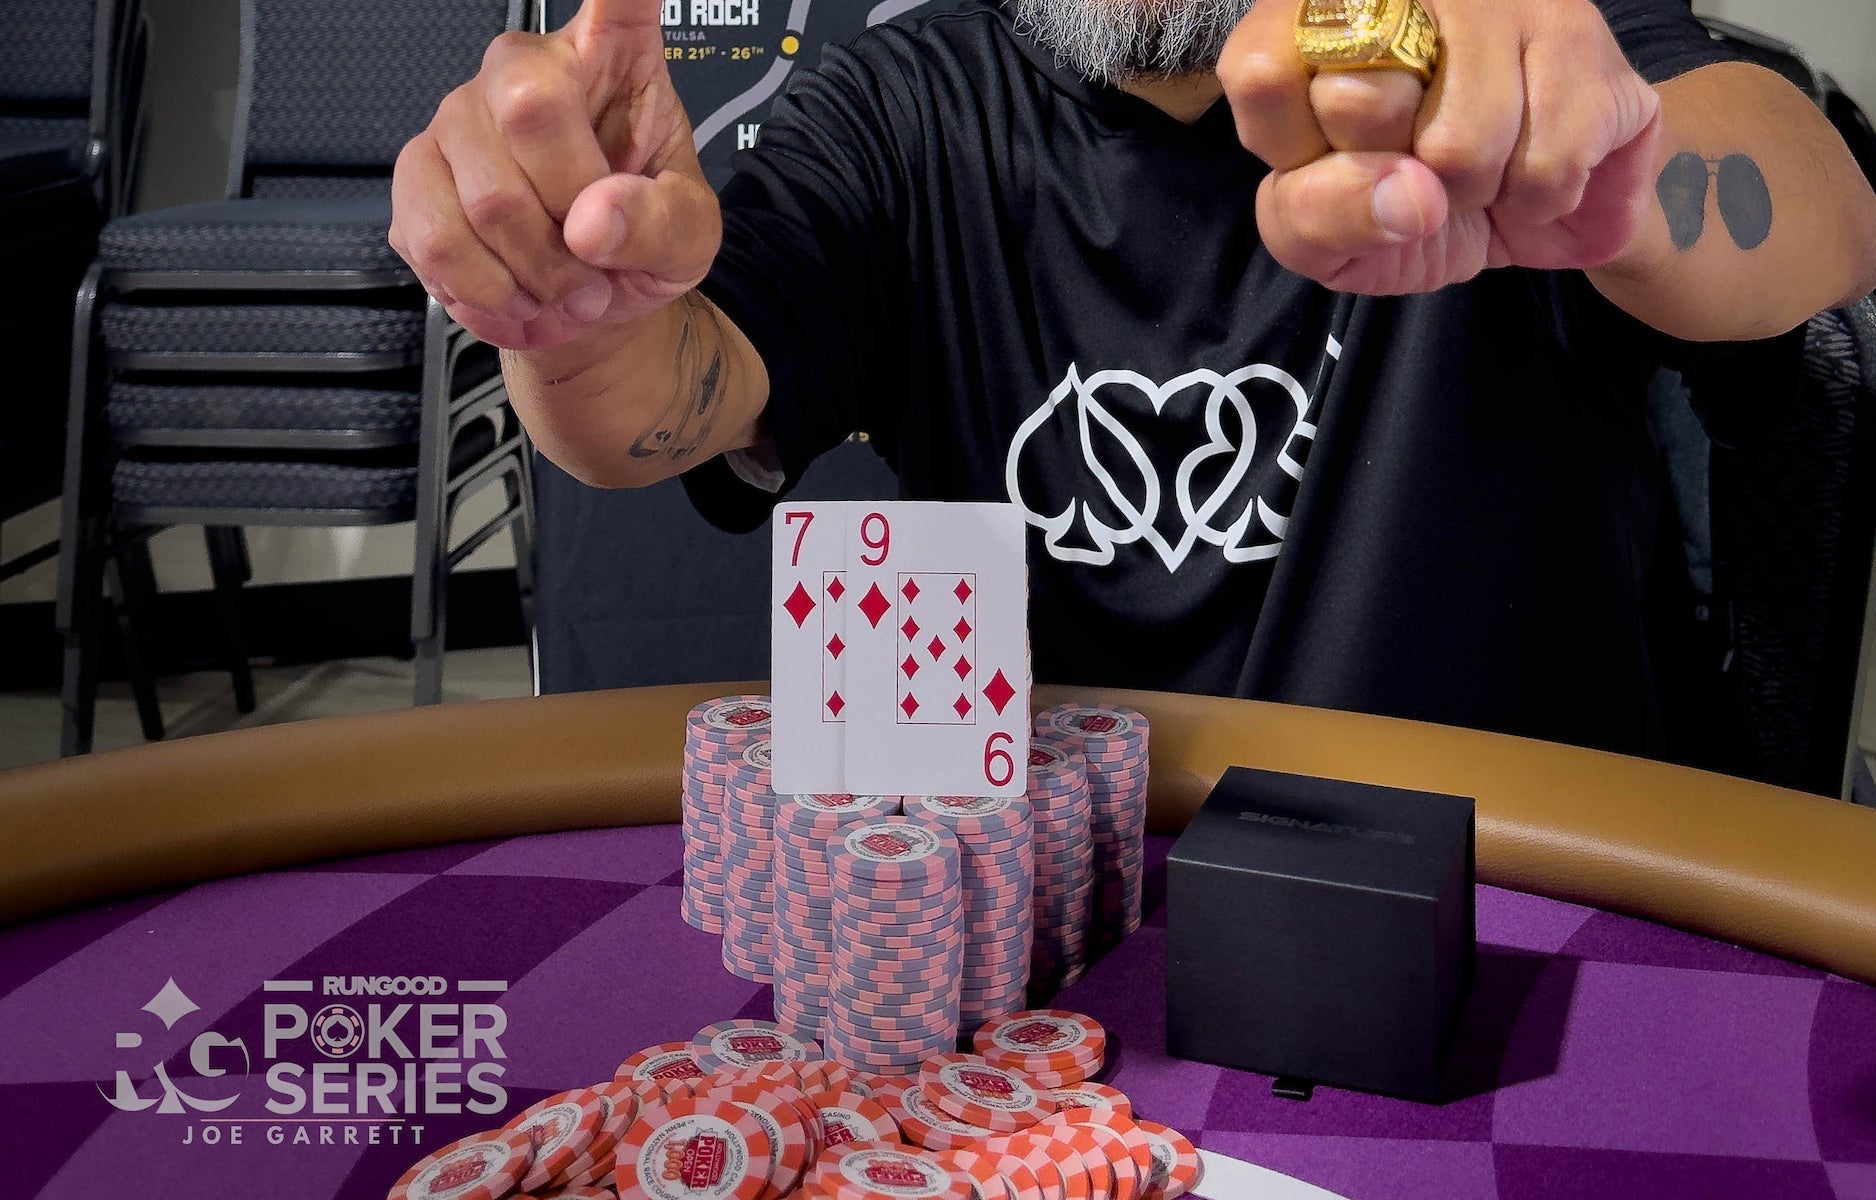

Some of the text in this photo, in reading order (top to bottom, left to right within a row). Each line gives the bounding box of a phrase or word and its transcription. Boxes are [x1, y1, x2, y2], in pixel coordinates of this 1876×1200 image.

[665, 31, 706, 42] TULSA
[785, 512, 815, 567] 7
[860, 512, 891, 566] 9
[1236, 810, 1417, 846] SIGNATURE
[821, 1112, 851, 1121] CASINO
[682, 1148, 696, 1174] OPEN
[691, 1136, 717, 1189] POKER
